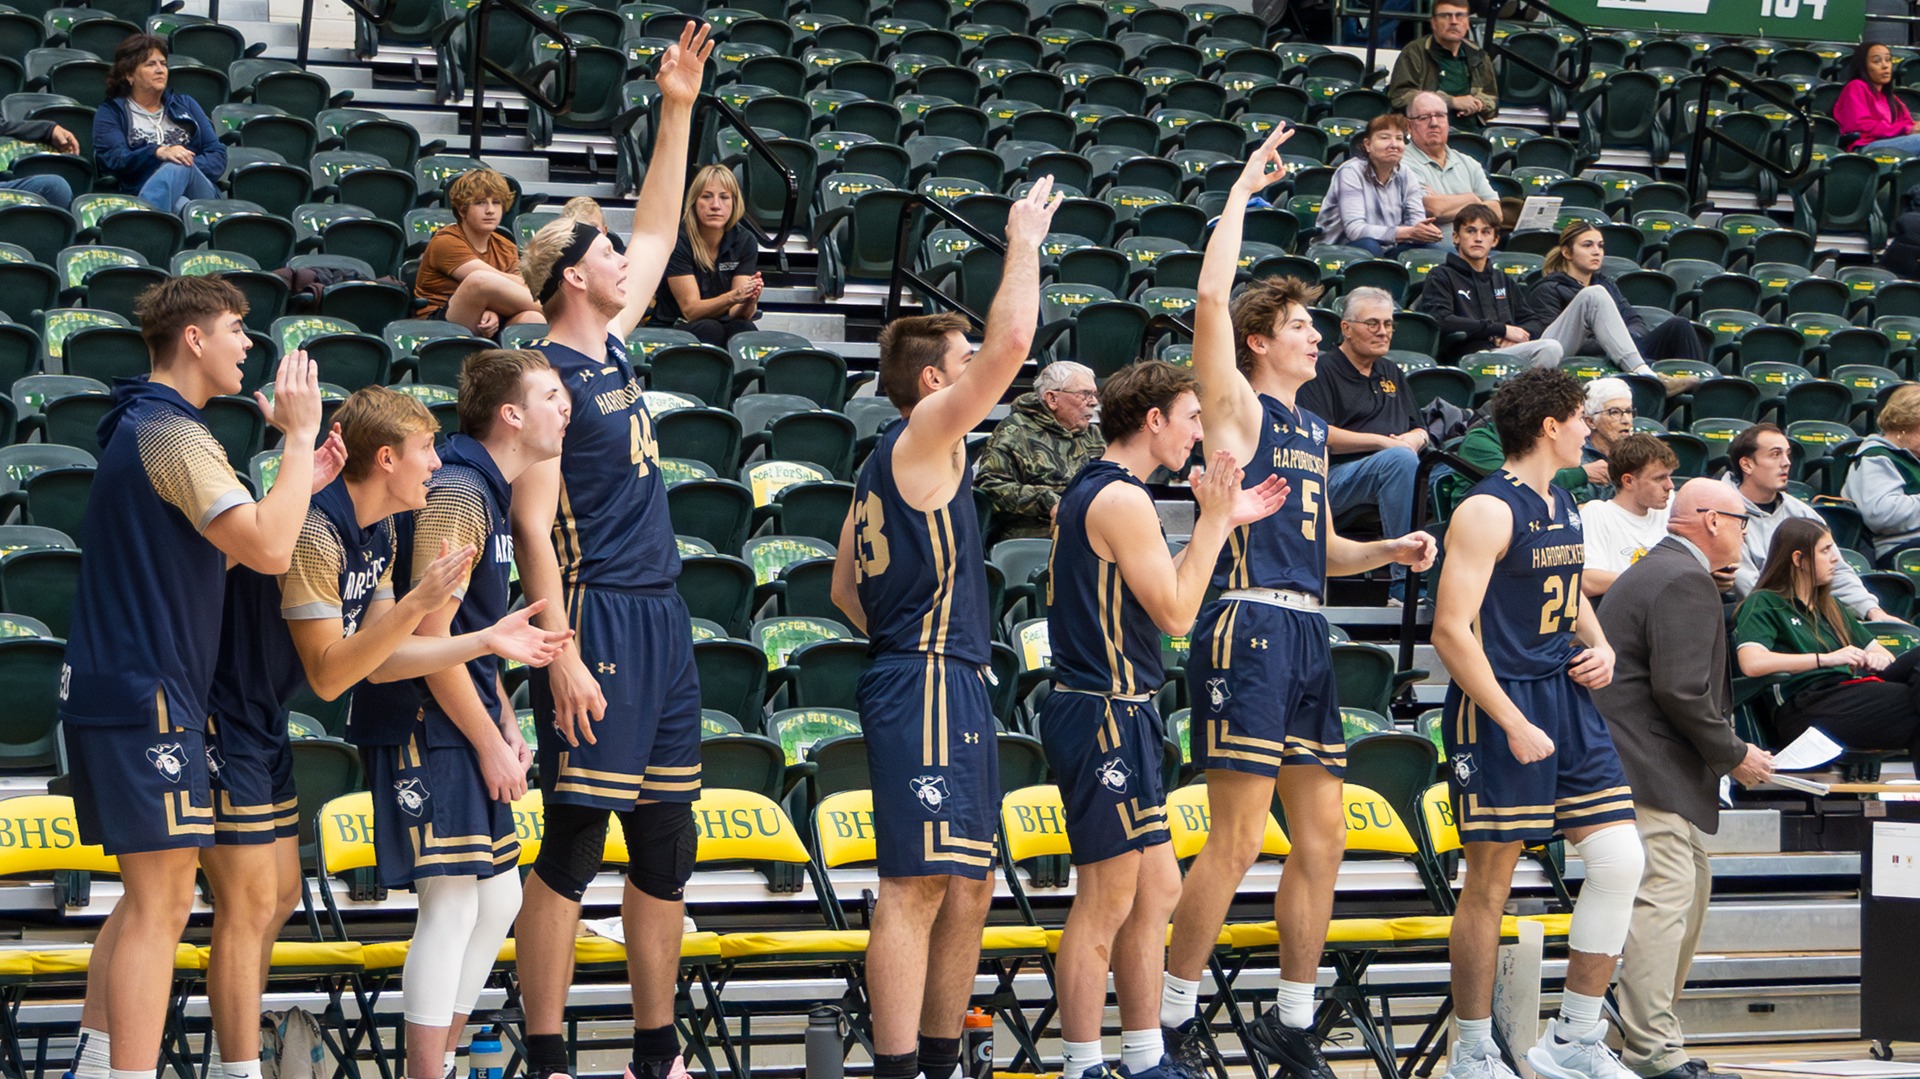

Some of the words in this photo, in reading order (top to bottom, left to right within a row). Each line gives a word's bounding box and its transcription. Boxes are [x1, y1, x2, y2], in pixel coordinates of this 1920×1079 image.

[629, 408, 660, 478] 44
[1301, 478, 1321, 541] 5
[1539, 572, 1579, 635] 24
[788, 621, 807, 631] FOR
[807, 711, 828, 724] FOR
[1012, 804, 1067, 834] BH
[1342, 801, 1393, 831] SU
